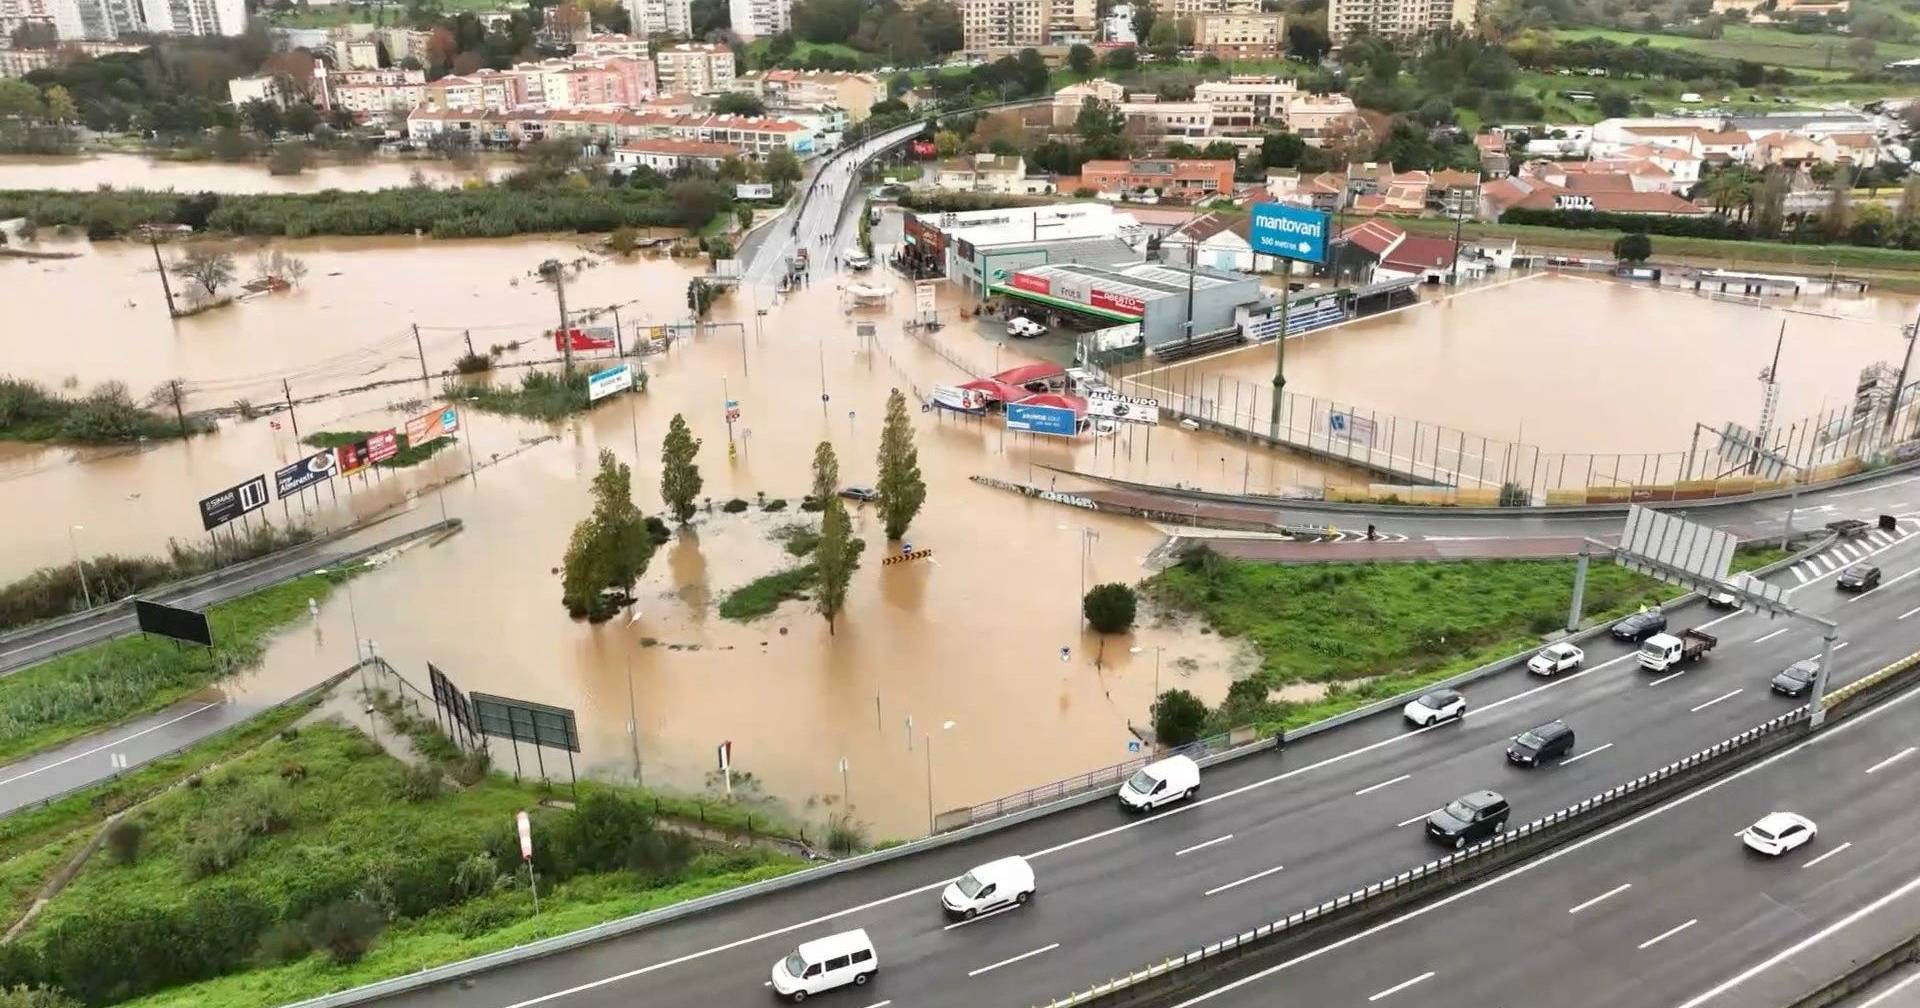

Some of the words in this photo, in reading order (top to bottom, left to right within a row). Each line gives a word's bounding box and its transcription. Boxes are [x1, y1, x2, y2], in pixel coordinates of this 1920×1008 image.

[1256, 215, 1321, 238] mantovani
[1104, 293, 1136, 306] ABERTO
[1089, 391, 1158, 406] ALUGATUDO
[210, 492, 235, 507] SIMAR
